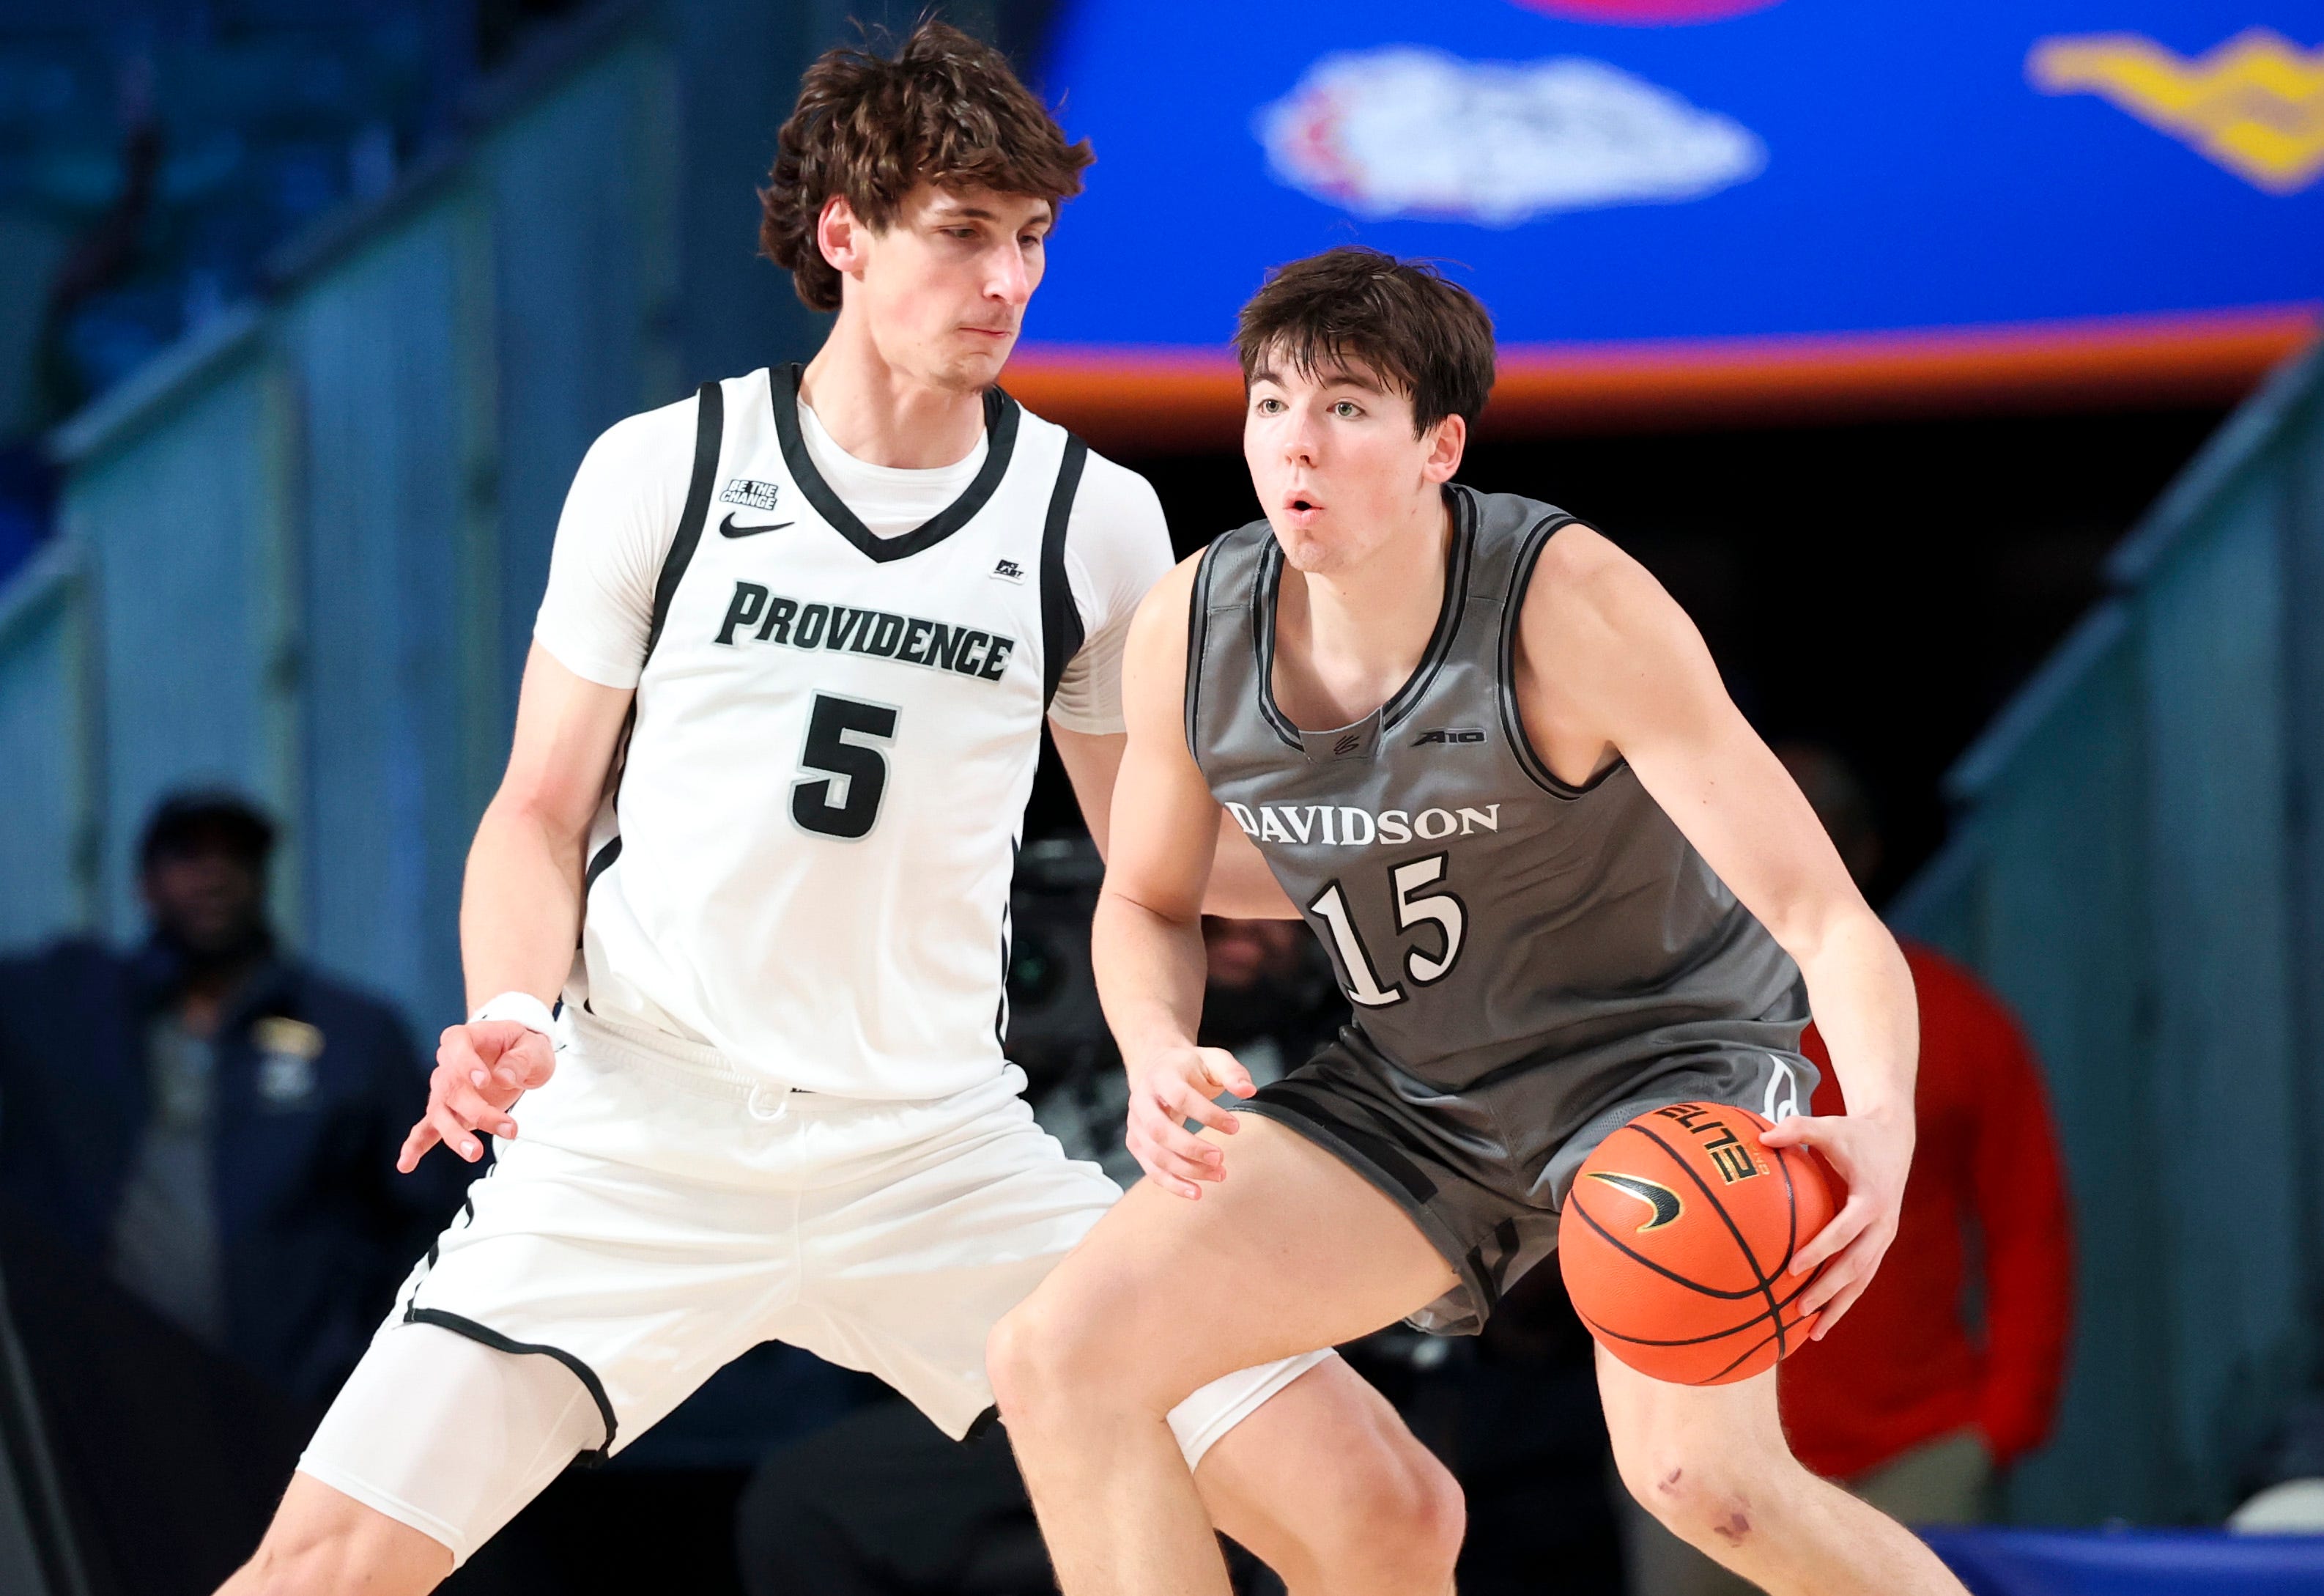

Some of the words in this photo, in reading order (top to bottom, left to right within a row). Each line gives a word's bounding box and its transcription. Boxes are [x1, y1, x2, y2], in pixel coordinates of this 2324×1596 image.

[720, 490, 777, 509] CHANGE
[728, 480, 748, 492] BE
[750, 481, 777, 497] THE
[713, 580, 1016, 684] PROVIDENCE
[788, 689, 902, 843] 5
[1224, 802, 1500, 846] DAVIDSON
[1307, 851, 1468, 1009] 15
[1653, 1104, 1759, 1184] ELITE
